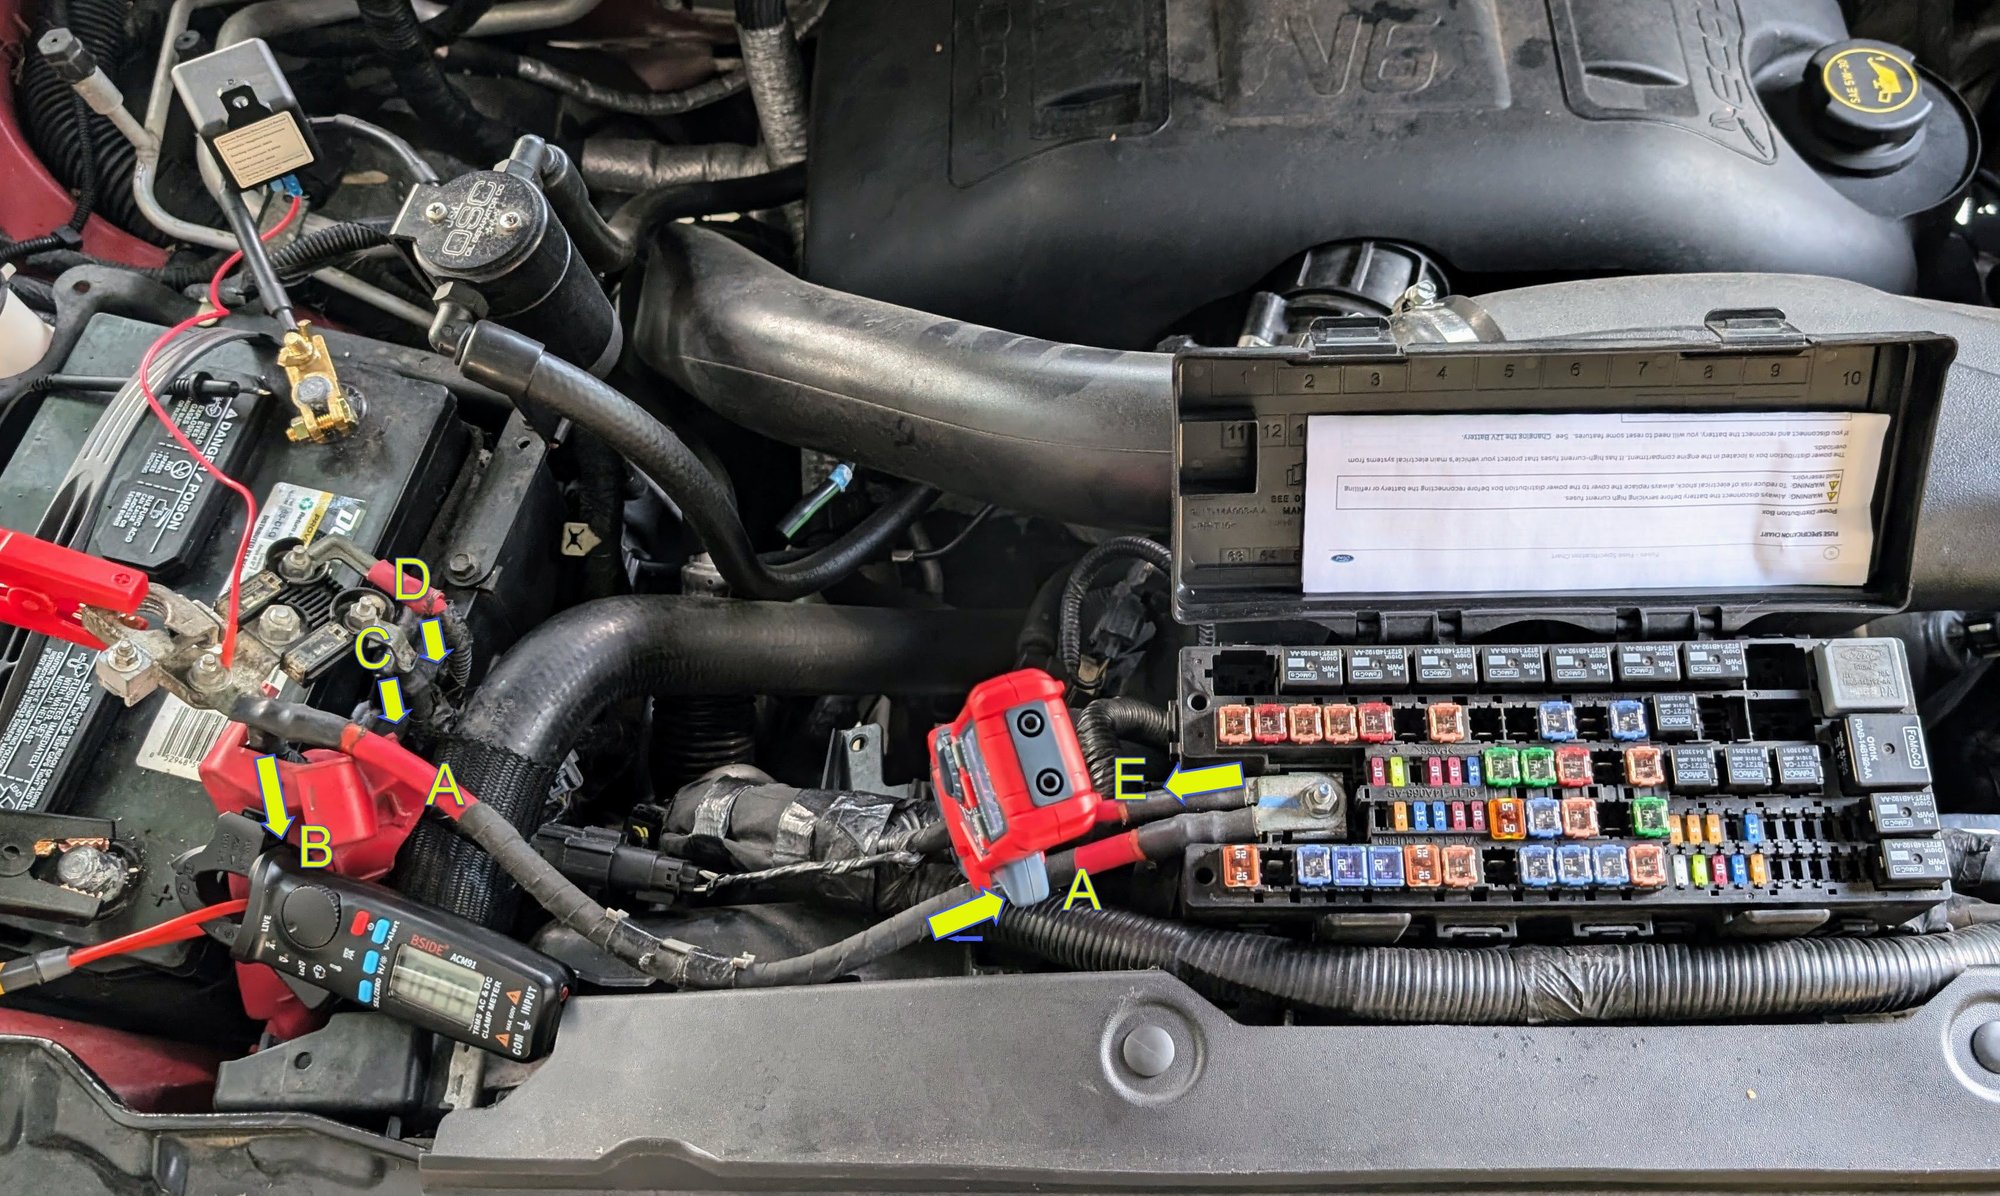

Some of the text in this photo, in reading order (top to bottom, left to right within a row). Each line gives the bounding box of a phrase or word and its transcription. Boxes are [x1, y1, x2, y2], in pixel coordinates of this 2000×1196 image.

[1284, 12, 1441, 96] V6
[1847, 87, 1861, 102] SAE
[442, 180, 497, 256] OSC
[1304, 374, 1314, 388] 2
[1371, 373, 1380, 386] 3
[1436, 366, 1447, 380] 4
[1504, 364, 1514, 378] 5
[1570, 362, 1580, 376] 6
[1638, 362, 1648, 376] 7
[1704, 365, 1713, 378] 8
[1770, 363, 1781, 377] 9
[1842, 371, 1861, 386] 10
[183, 403, 198, 425] GASES
[192, 421, 204, 438] EYES
[196, 422, 211, 445] SHIELD
[1228, 424, 1282, 440] 11 12
[164, 461, 172, 471] NO
[1343, 484, 1371, 492] refilling
[1380, 484, 1405, 492] battery
[1504, 484, 1545, 492] distribution
[1623, 482, 1649, 490] replace
[1650, 481, 1674, 489] always
[1675, 481, 1697, 489] shock,
[1698, 481, 1730, 489] electrical
[1790, 481, 1824, 489] WARNING:
[1628, 493, 1658, 501] servicing
[1683, 492, 1707, 500] battery
[1760, 491, 1785, 499] Always
[167, 483, 200, 531] POISON
[124, 495, 155, 543] SULFURIC ACID
[59, 677, 73, 698] WITH
[22, 675, 66, 745] MEDICAL HELP FAST
[28, 678, 81, 769] FLUSH EYES IMMEDIATELY
[35, 723, 48, 738] GET
[1906, 729, 1921, 767] FoMoCo
[9, 782, 22, 798] LEAD
[1502, 803, 1514, 812] 60
[1504, 824, 1516, 833] 60
[1235, 850, 1247, 859] 25
[1416, 849, 1428, 858] 25
[1236, 872, 1248, 881] 25
[1418, 871, 1430, 879] 25
[261, 914, 272, 933] LIVE
[450, 953, 477, 970] ACM91
[472, 1012, 482, 1035] TRMS
[478, 998, 486, 1011] AC
[483, 975, 492, 989] DC
[481, 980, 502, 1039] CLAMP METER
[512, 985, 538, 1056] COM INPUT
